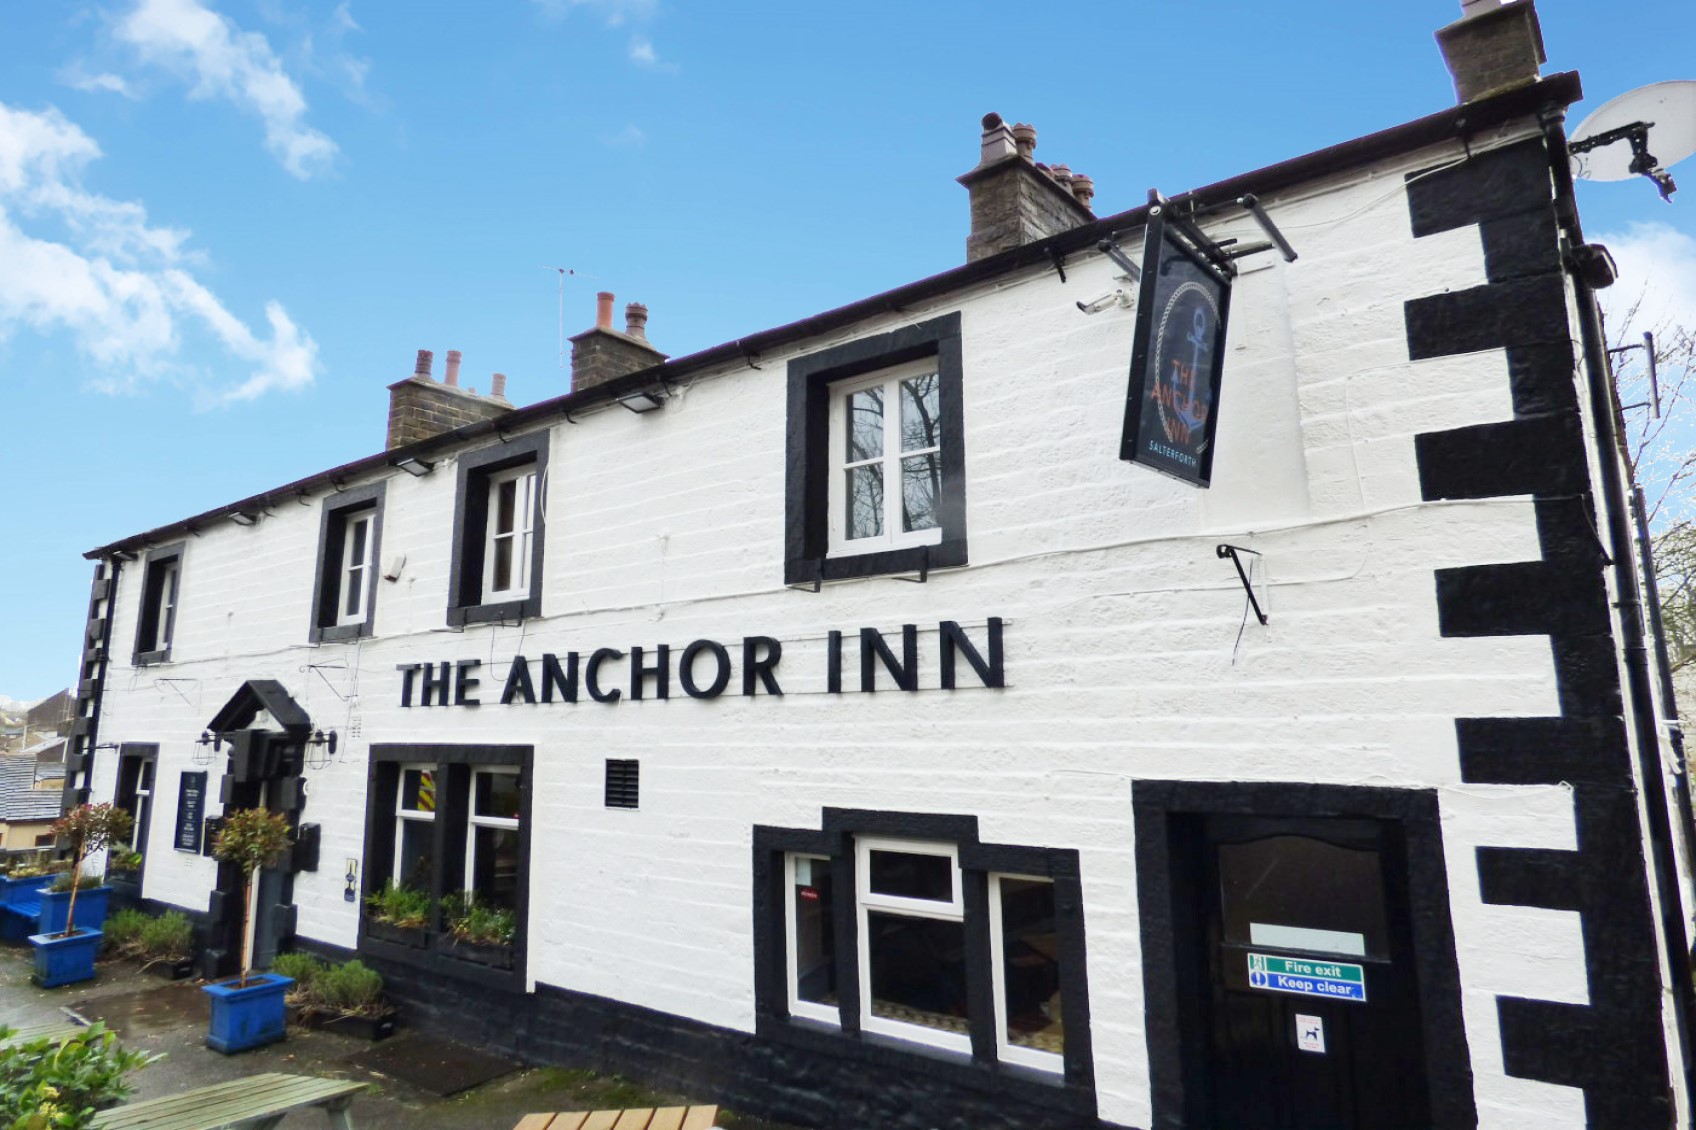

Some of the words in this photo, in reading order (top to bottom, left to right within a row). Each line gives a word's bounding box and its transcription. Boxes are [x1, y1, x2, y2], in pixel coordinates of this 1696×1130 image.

[1148, 440, 1197, 466] SALTERFORTH
[396, 659, 482, 707] THE
[500, 636, 783, 705] ANCHOR
[828, 617, 1005, 694] INN
[1284, 960, 1312, 974] Fire
[1315, 965, 1342, 978] exit
[1277, 975, 1313, 992] Keep
[1316, 981, 1353, 995] clear
